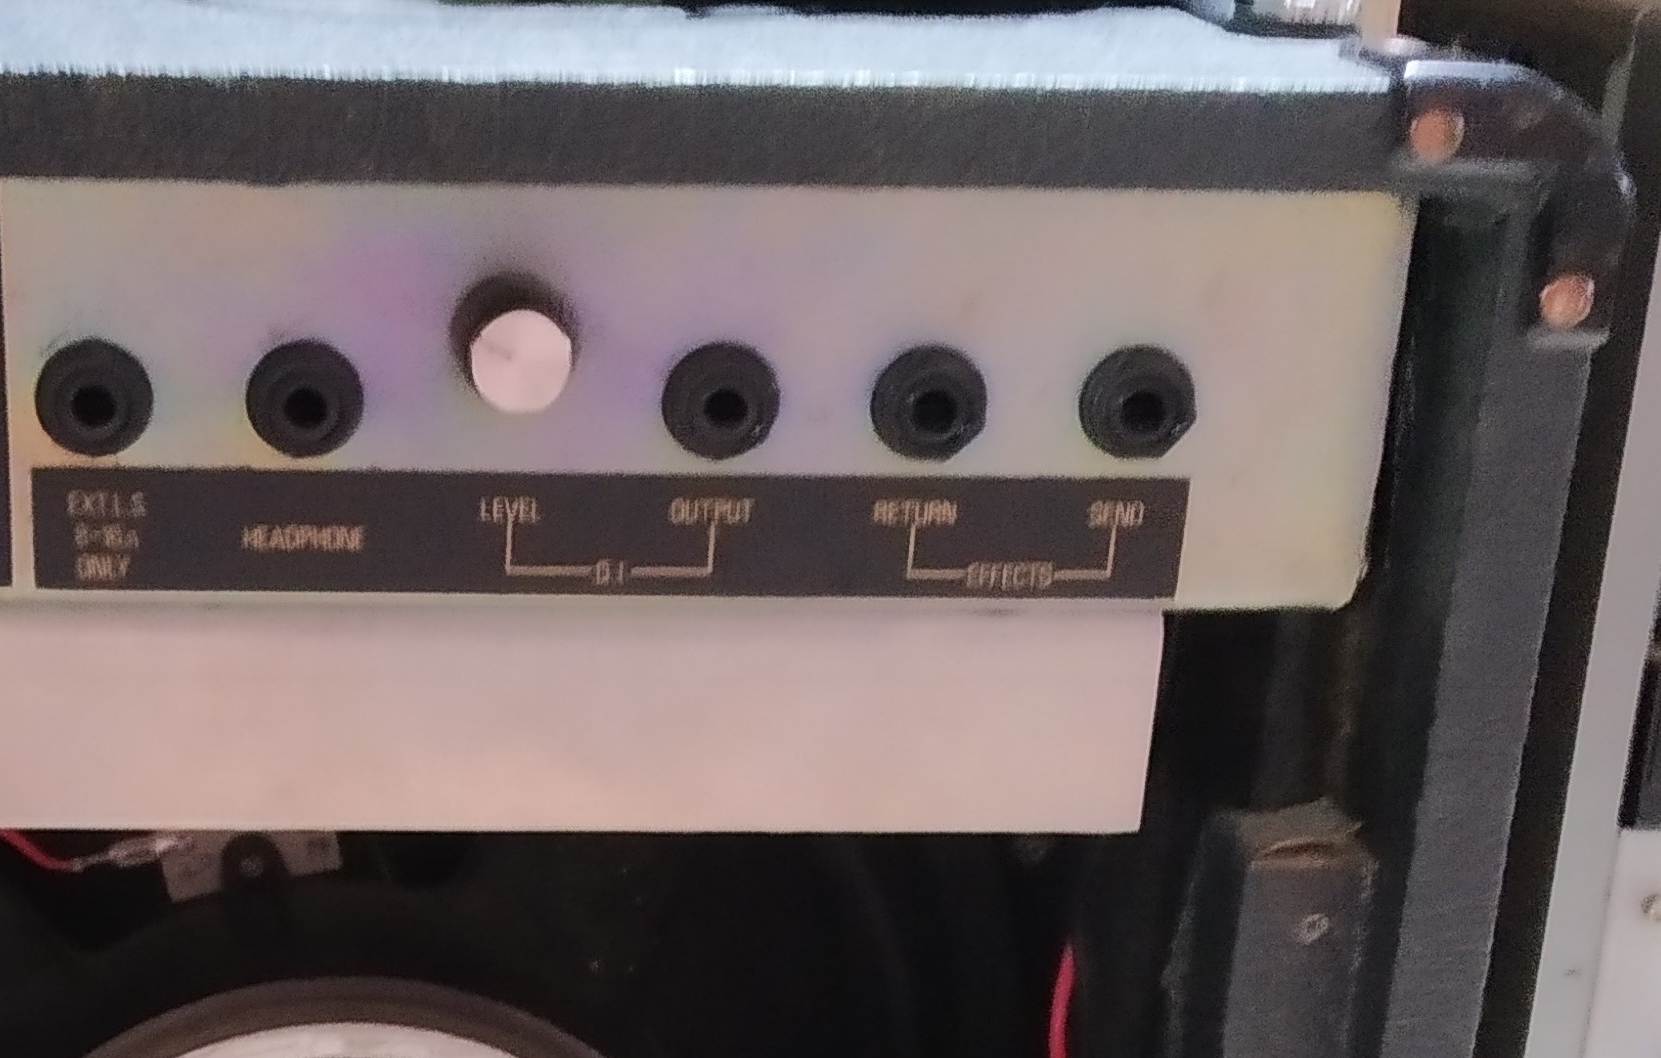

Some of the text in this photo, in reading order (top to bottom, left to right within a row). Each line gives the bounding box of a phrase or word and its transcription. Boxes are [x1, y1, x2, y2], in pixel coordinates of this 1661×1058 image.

[478, 495, 541, 524] LEVEL
[668, 497, 755, 526] OUTPUT
[872, 499, 959, 527] RETURN
[1087, 500, 1146, 528] SEND
[241, 523, 366, 553] HEADPHONE
[75, 553, 132, 581] ONLY
[965, 561, 1055, 590] EFFECTS
